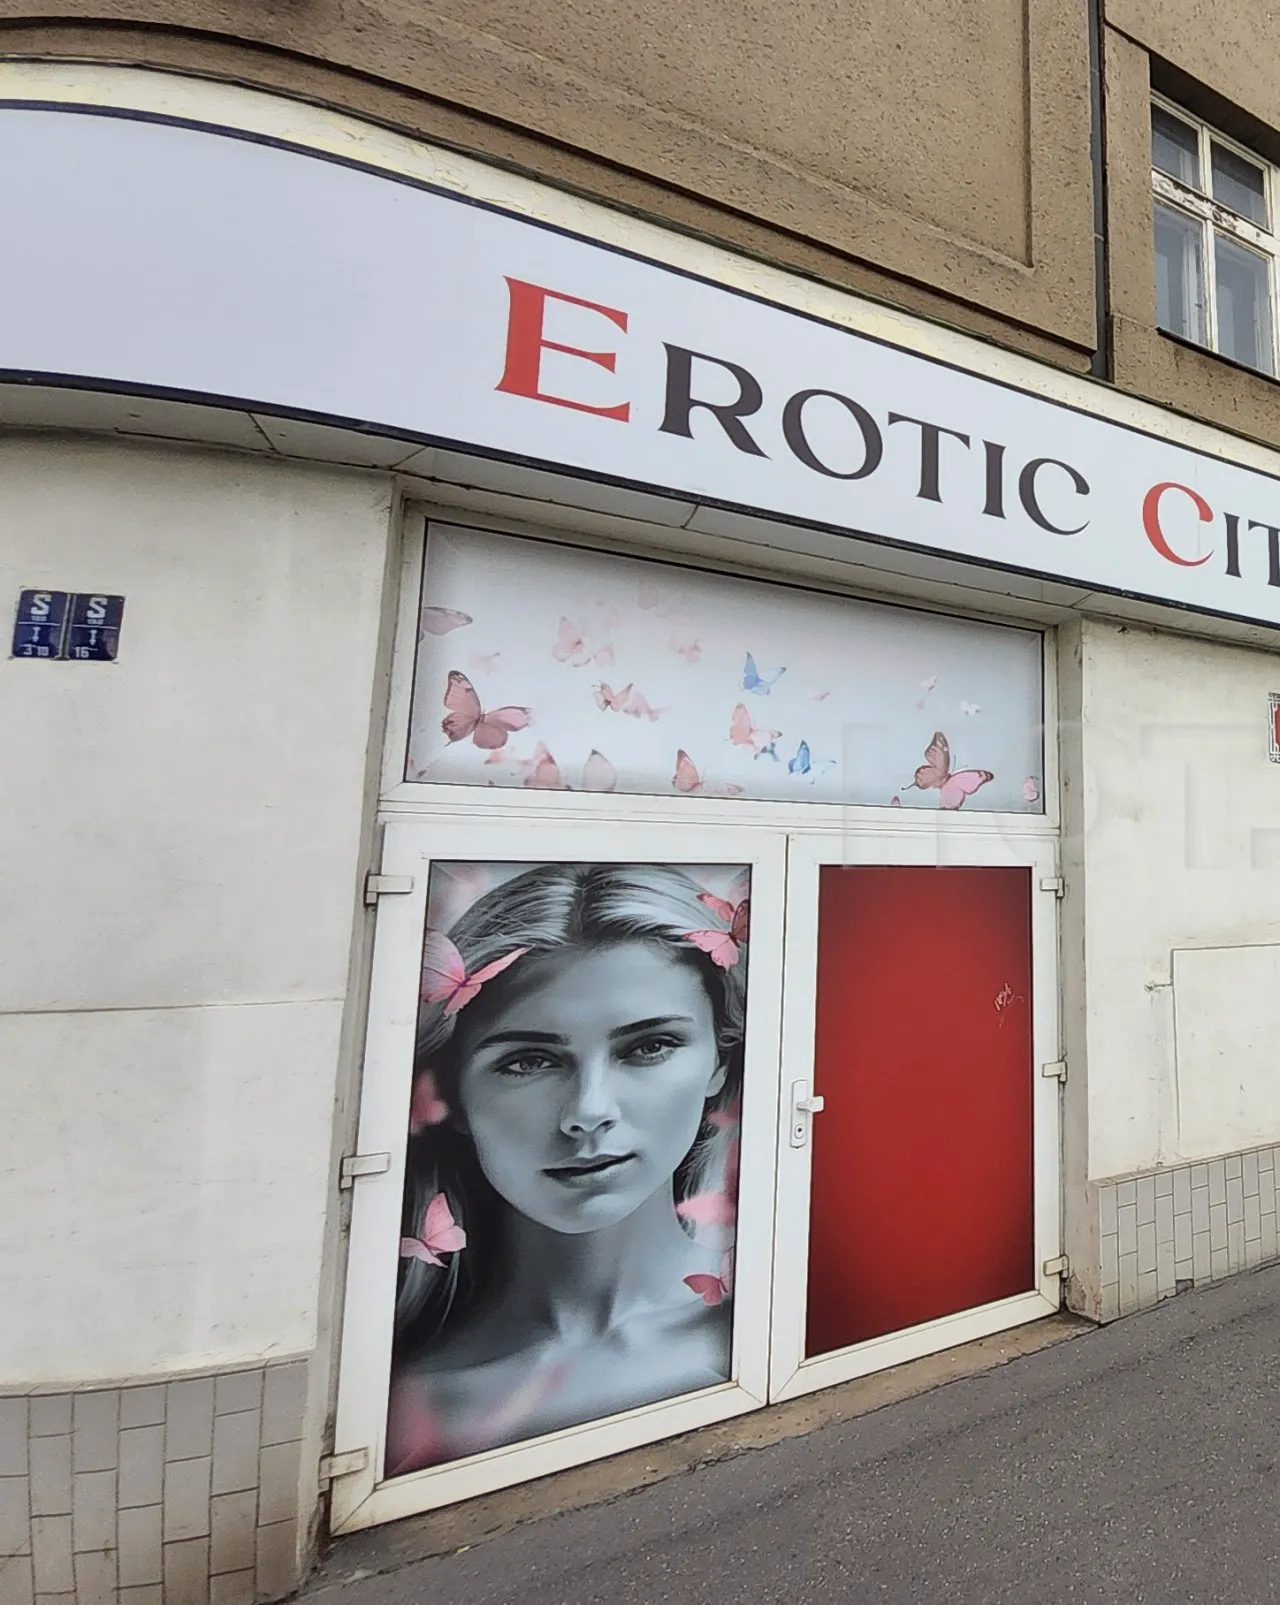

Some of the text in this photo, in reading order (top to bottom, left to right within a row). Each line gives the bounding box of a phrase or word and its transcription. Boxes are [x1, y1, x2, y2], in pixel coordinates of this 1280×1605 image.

[494, 275, 1091, 535] EROTIC
[30, 594, 52, 615] S
[86, 597, 108, 619] S
